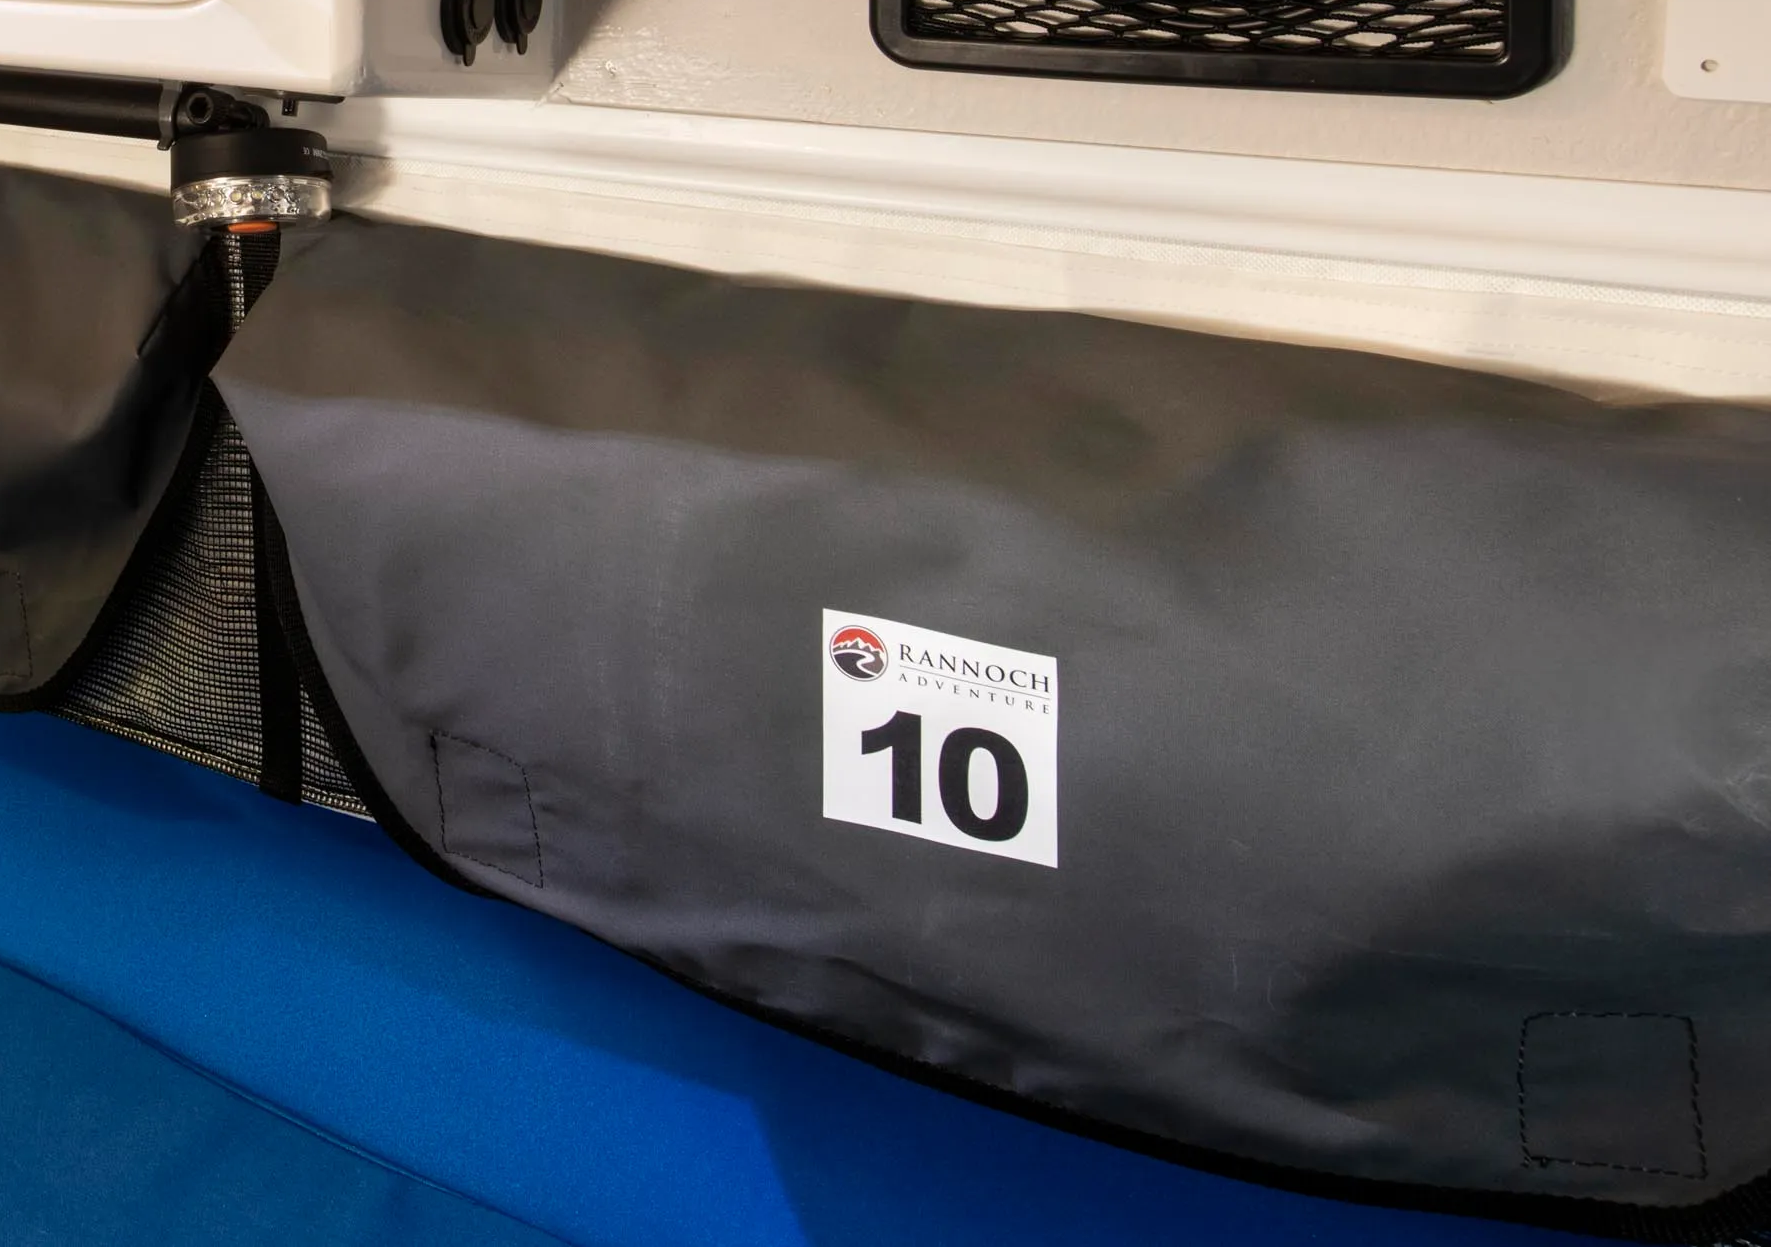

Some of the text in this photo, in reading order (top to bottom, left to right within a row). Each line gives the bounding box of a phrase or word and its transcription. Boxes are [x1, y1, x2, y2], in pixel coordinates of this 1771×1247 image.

[899, 642, 1051, 694] RANNOCH
[899, 673, 1050, 715] ADVENTURE
[861, 710, 1029, 843] 10
